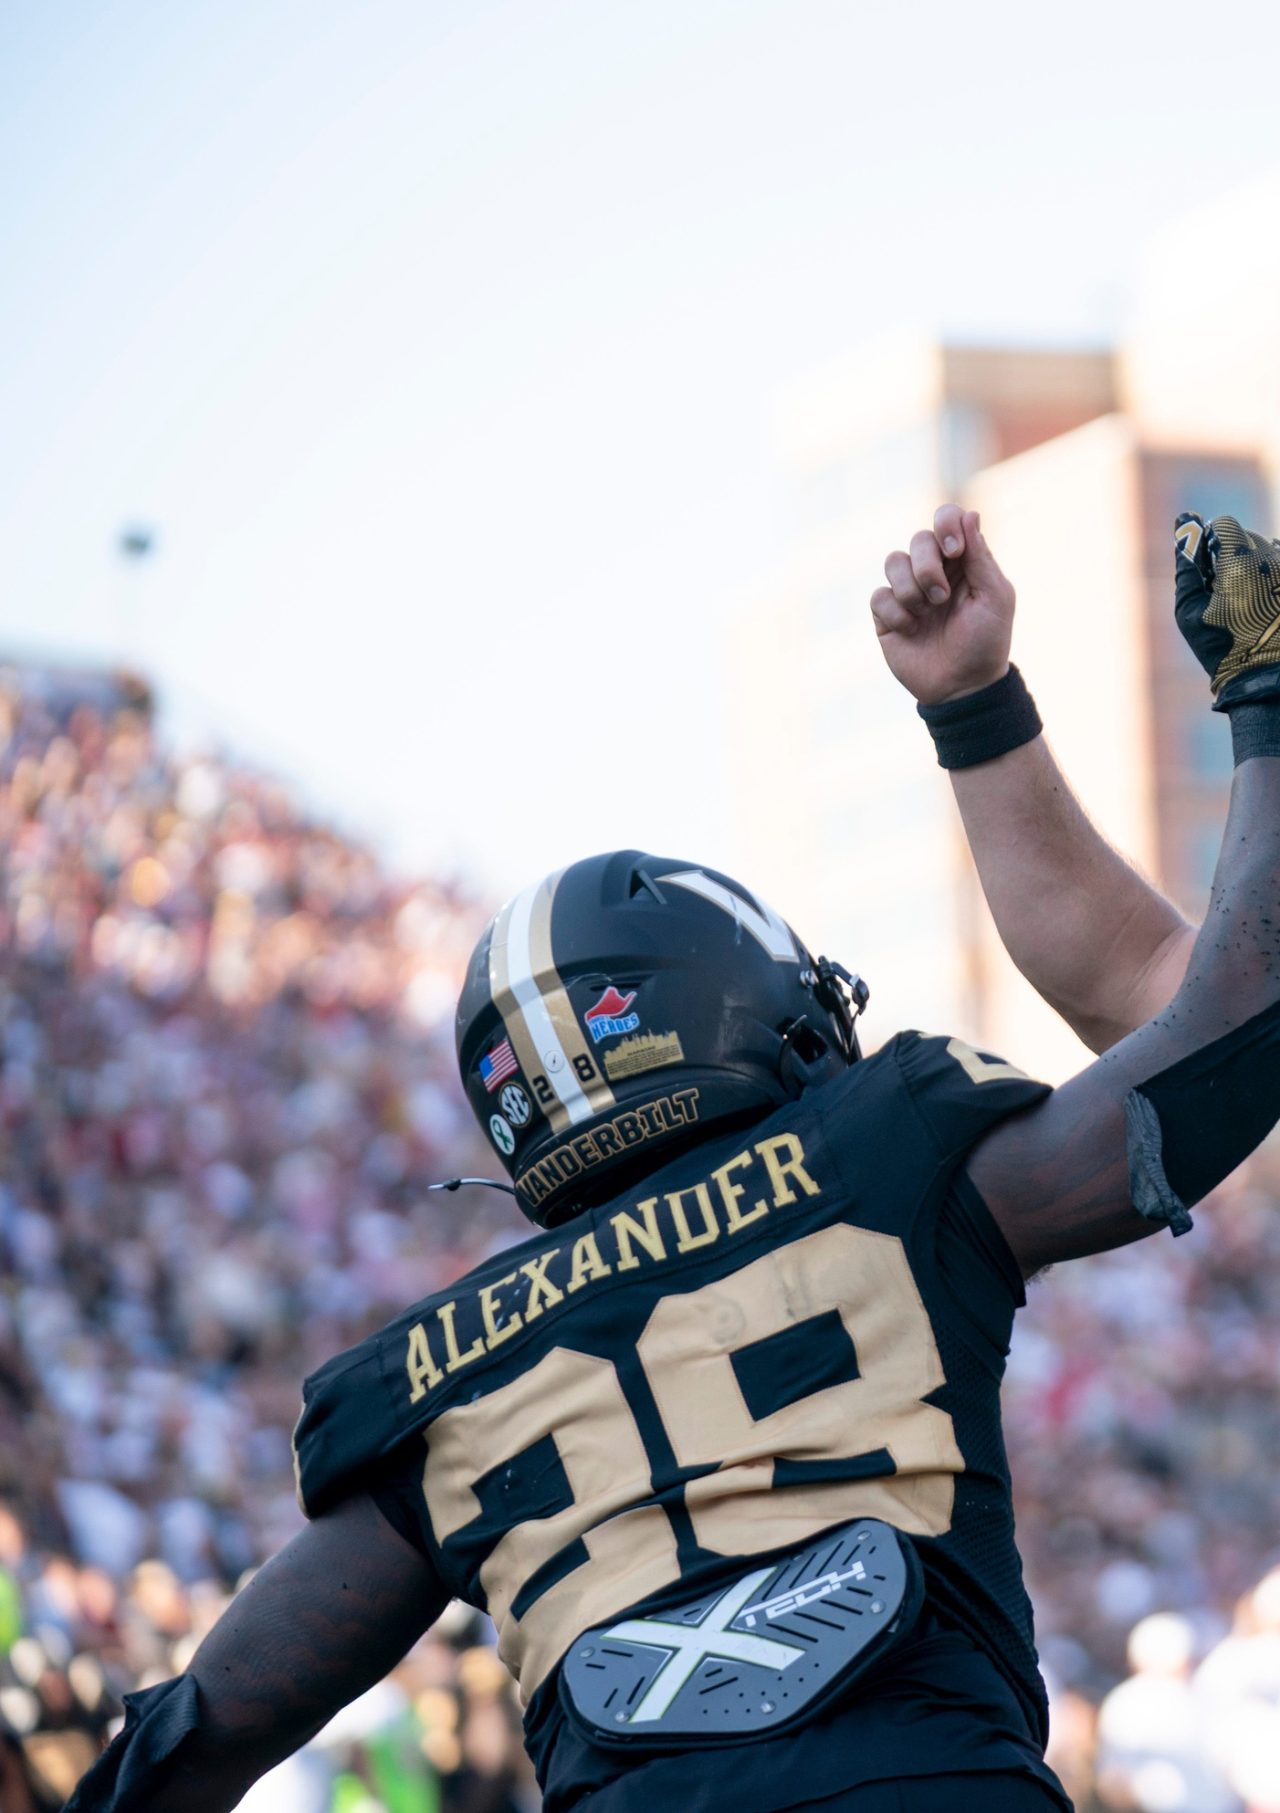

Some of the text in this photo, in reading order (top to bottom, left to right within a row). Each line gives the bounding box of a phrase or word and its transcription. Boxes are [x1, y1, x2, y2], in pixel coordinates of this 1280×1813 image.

[591, 1014, 639, 1041] HEROES
[502, 1084, 530, 1125] SEC
[533, 1075, 555, 1104] 2
[572, 1053, 596, 1082] 8
[515, 1087, 700, 1205] VANDERBILT
[405, 1131, 821, 1404] ALEXANDER
[421, 1222, 966, 1708] 28
